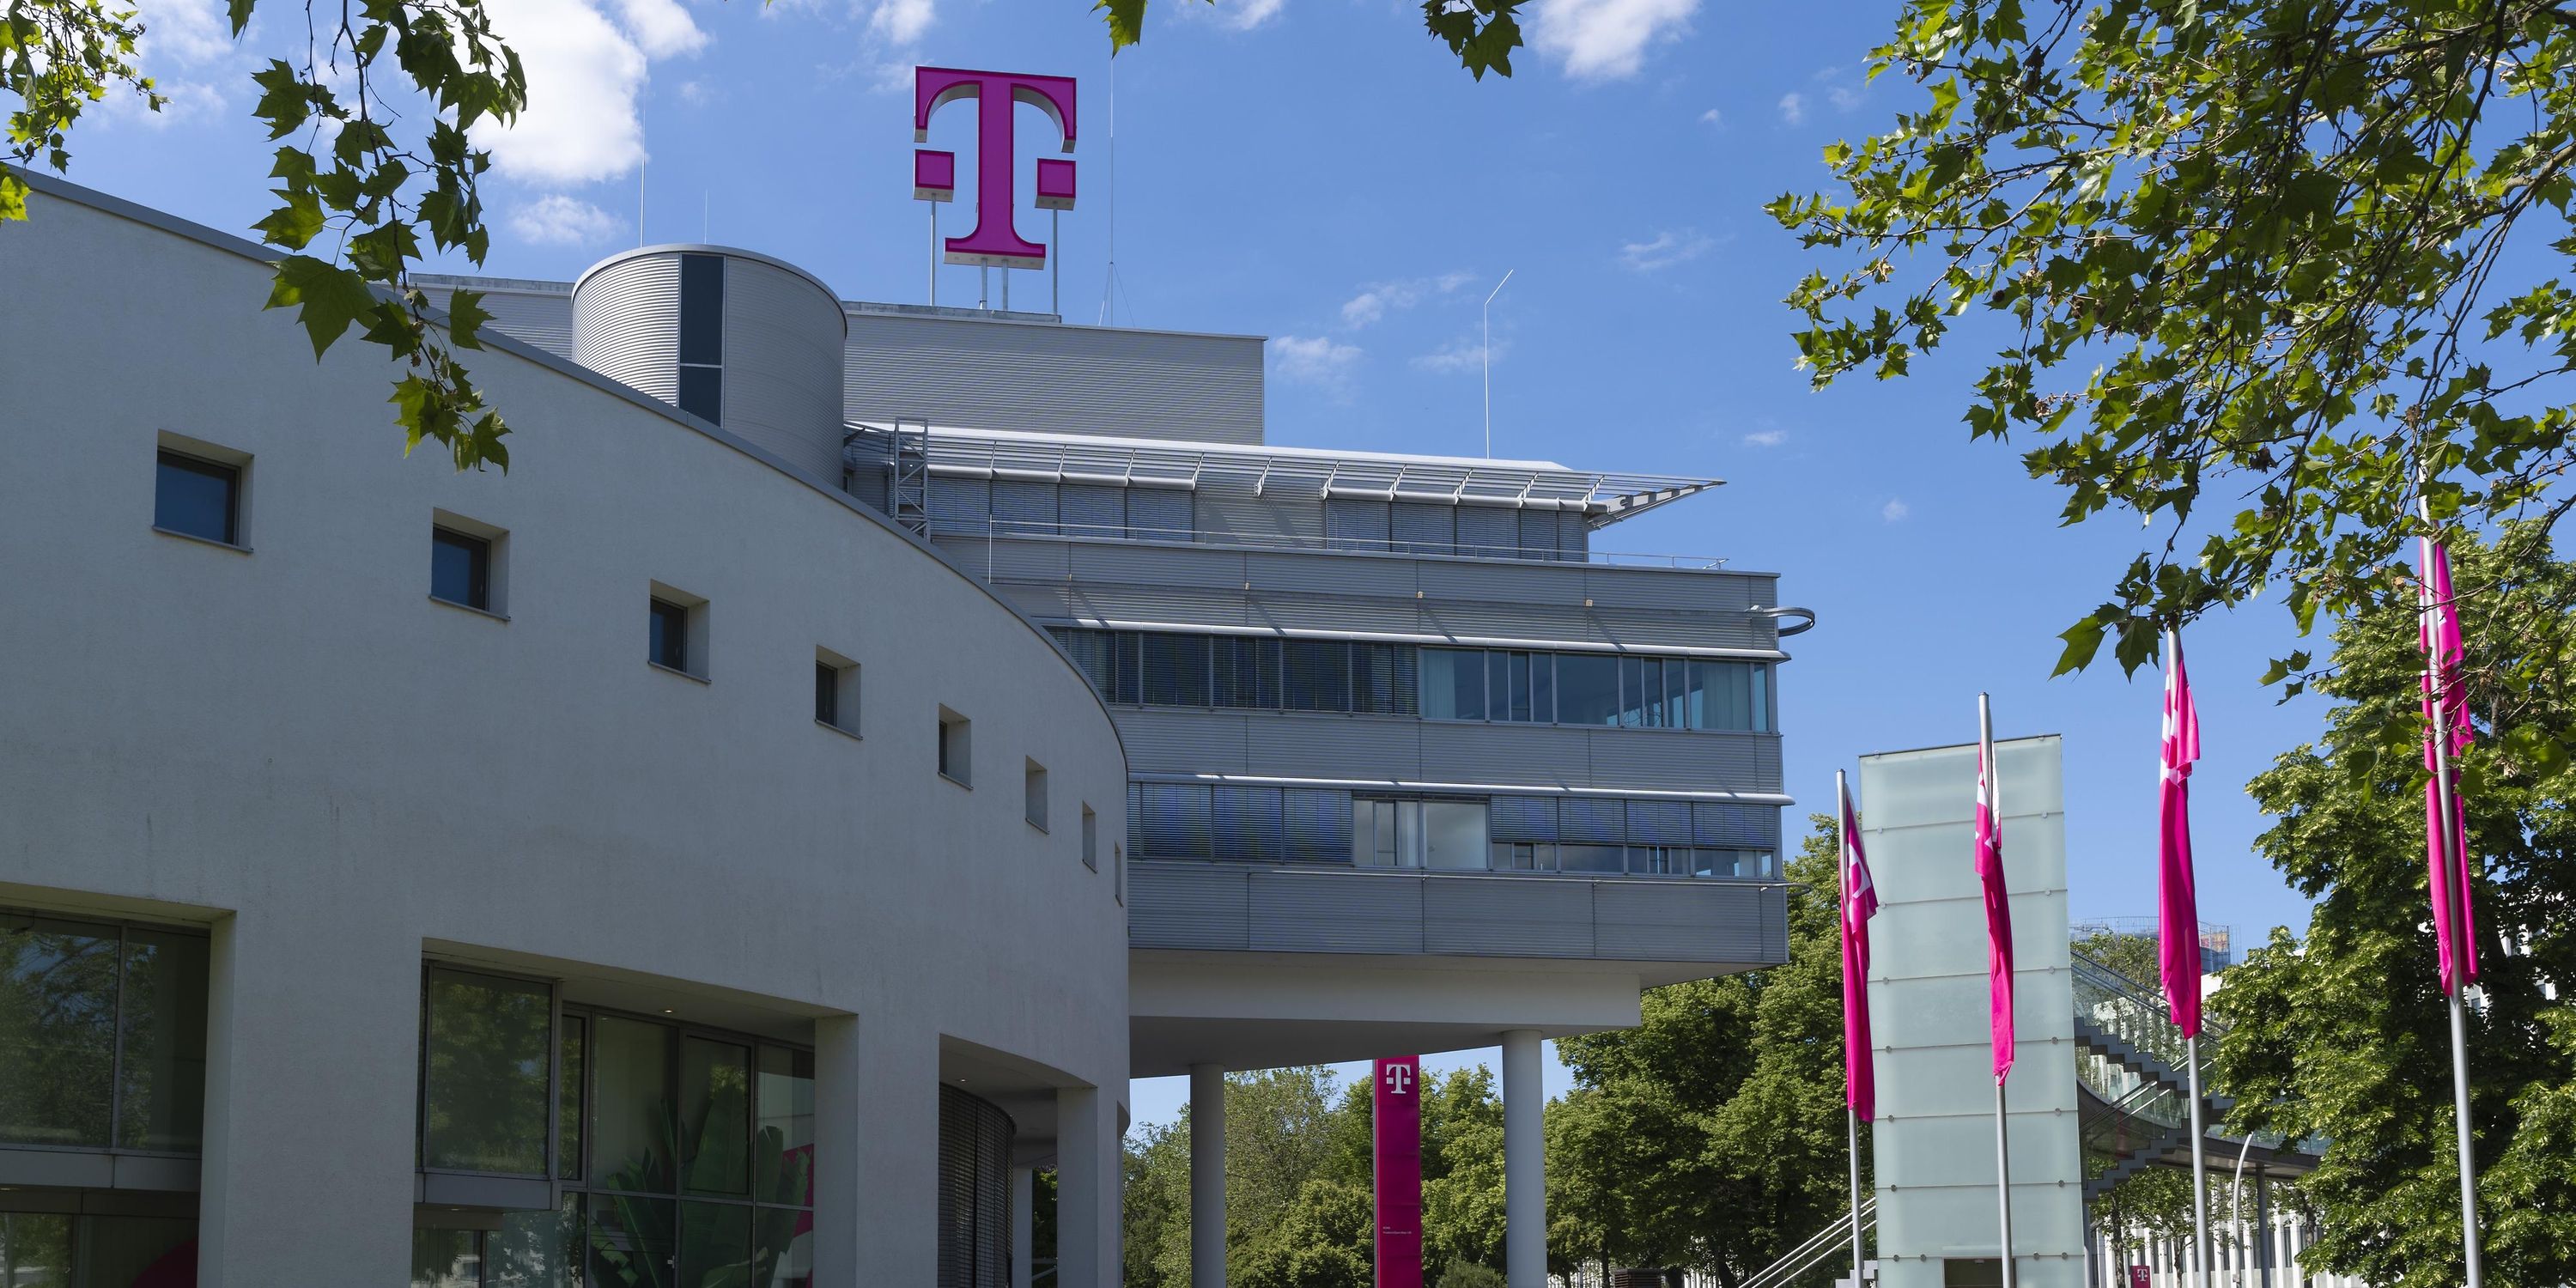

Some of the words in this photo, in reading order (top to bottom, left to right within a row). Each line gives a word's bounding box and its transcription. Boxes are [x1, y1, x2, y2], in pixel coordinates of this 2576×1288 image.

[914, 66, 1077, 259] T
[1386, 1064, 1411, 1094] T
[2137, 1268, 2148, 1282] T
